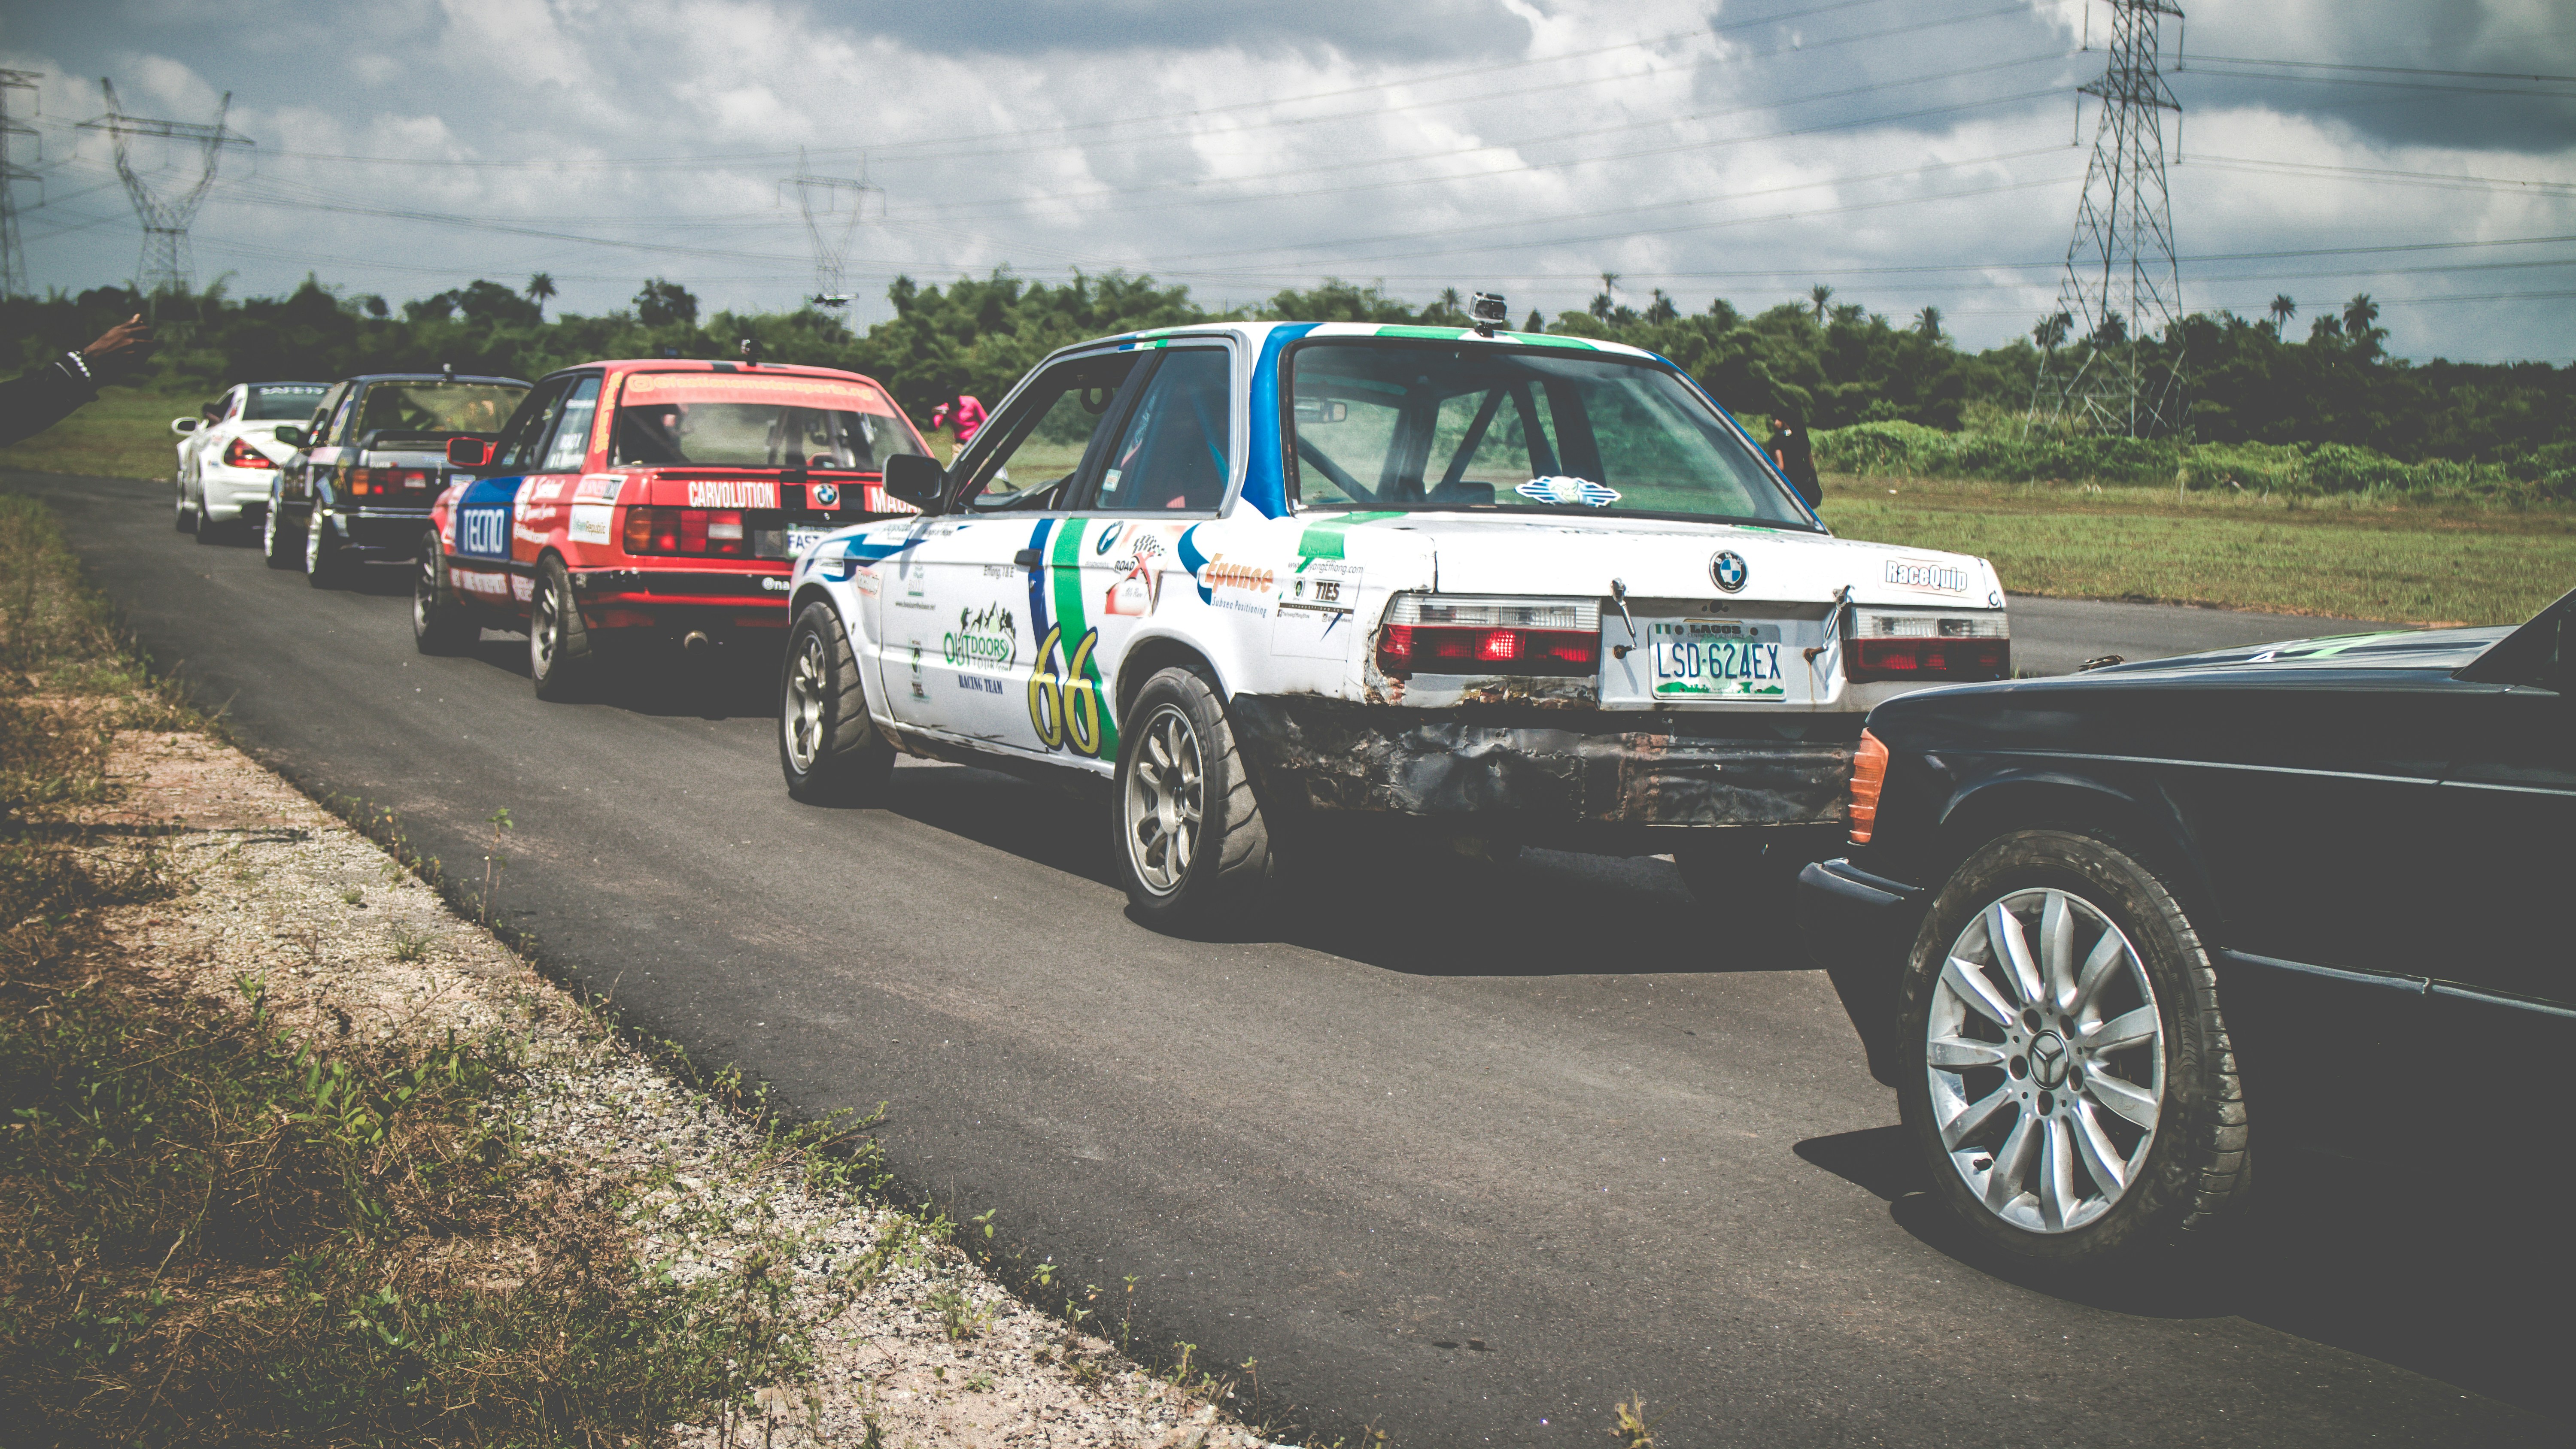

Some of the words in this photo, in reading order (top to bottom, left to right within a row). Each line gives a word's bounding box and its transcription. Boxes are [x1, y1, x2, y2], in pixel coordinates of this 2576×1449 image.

[688, 481, 775, 508] CARVOLUTION
[464, 509, 504, 553] TECNO
[1115, 560, 1136, 571] ROAD
[1886, 560, 1968, 592] RaceQuip
[1315, 581, 1340, 601] TIES
[1212, 597, 1233, 609] Subsea
[1234, 600, 1267, 618] Positioning
[943, 631, 1009, 667] OUTDOORS
[958, 674, 983, 691] RACING
[984, 679, 1003, 694] TEAM
[1028, 621, 1102, 759] 66
